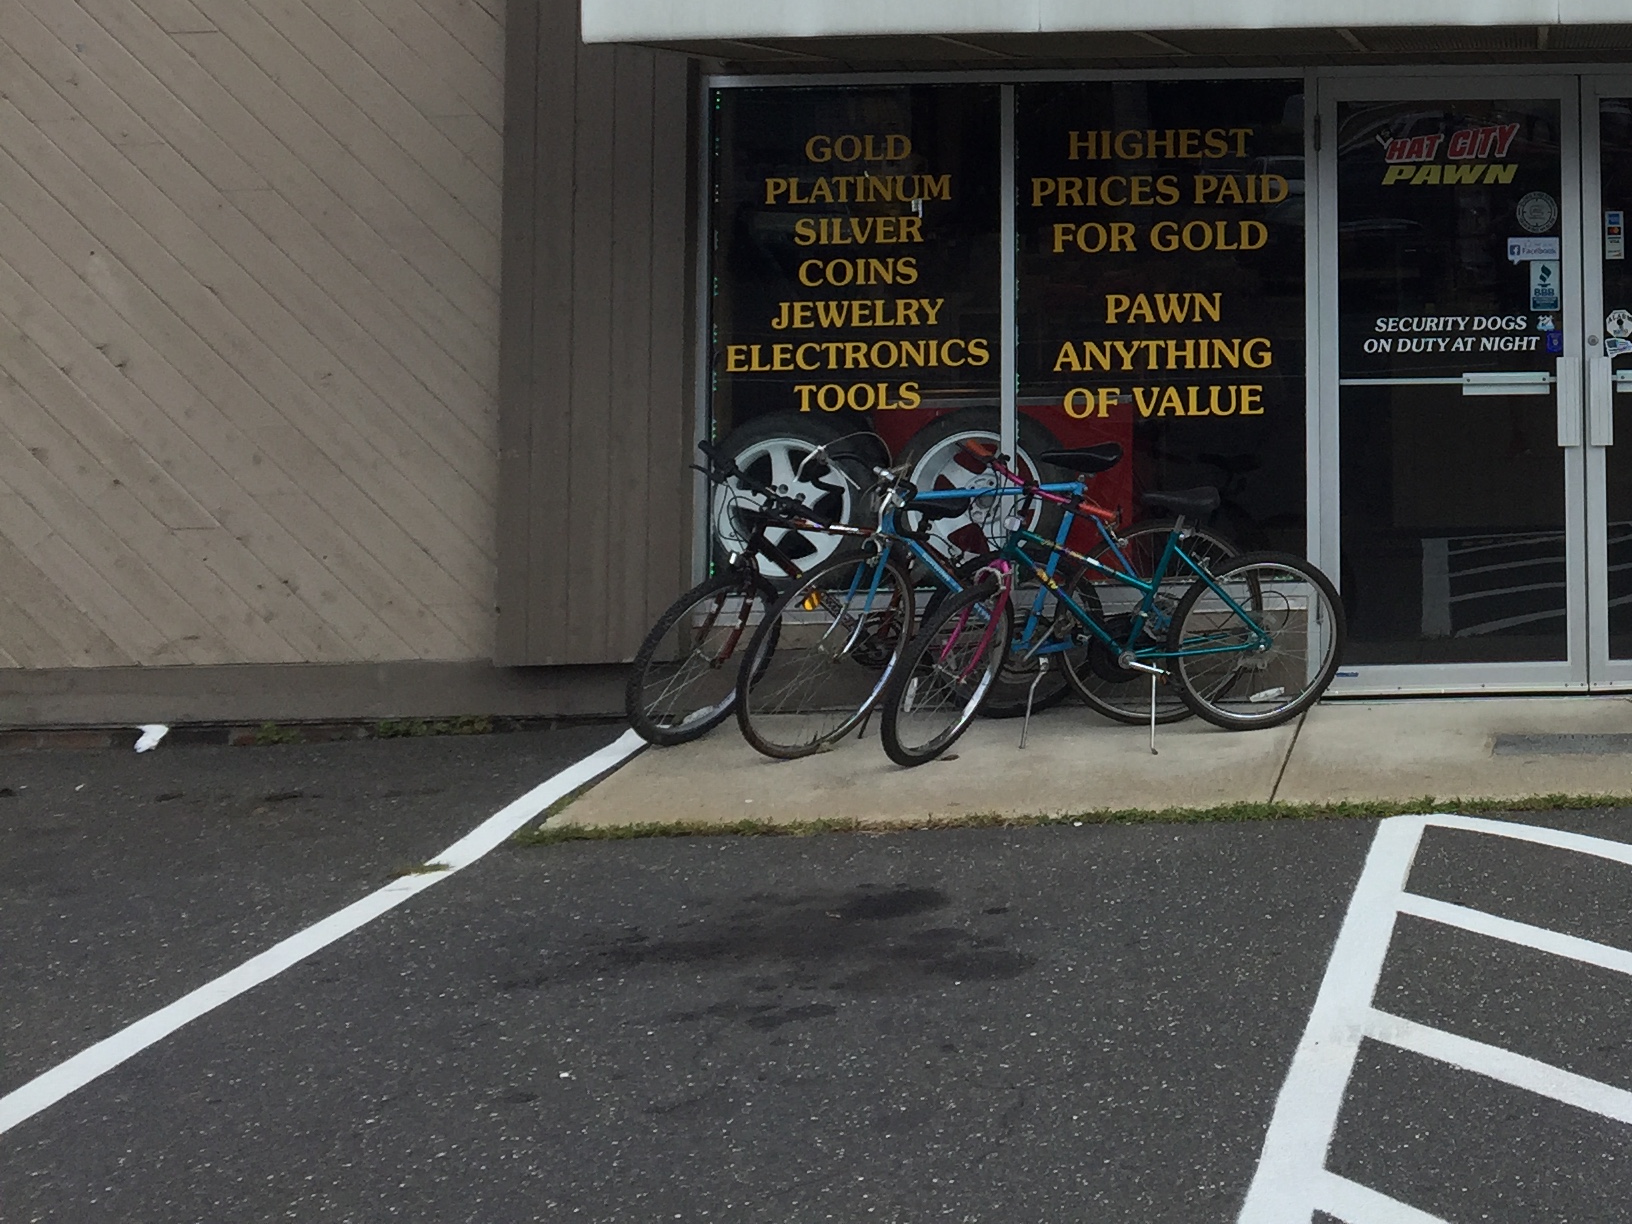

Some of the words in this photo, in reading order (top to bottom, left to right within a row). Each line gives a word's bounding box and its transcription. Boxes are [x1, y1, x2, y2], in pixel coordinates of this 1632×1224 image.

[805, 134, 912, 162] GOLD
[1068, 129, 1254, 160] HIGHEST
[1385, 134, 1445, 163] HAT
[1447, 123, 1520, 159] CITY
[765, 174, 951, 204] PLATINUM
[1381, 164, 1519, 185] PAWN
[1031, 175, 1180, 207] PRICES
[1194, 174, 1289, 204] PAID
[794, 217, 924, 245] SILVER
[1052, 223, 1137, 253] FOR
[1150, 221, 1268, 251] GOLD
[798, 258, 918, 287] COINS
[1534, 288, 1555, 297] BBB
[771, 299, 944, 329] JEWELRY
[1105, 293, 1222, 324] PAWN
[1375, 316, 1469, 332] SECURITY
[1472, 315, 1527, 331] DOGS
[726, 339, 990, 372] ELECTRONICS
[1054, 339, 1273, 371] ANYTHING
[1363, 338, 1392, 353] ON
[1397, 337, 1451, 352] DUTY
[1451, 336, 1477, 351] AT
[1479, 336, 1540, 351] NIGHT
[794, 383, 921, 412] TOOLS
[1063, 388, 1120, 419] OF
[1132, 385, 1265, 416] VALUE
